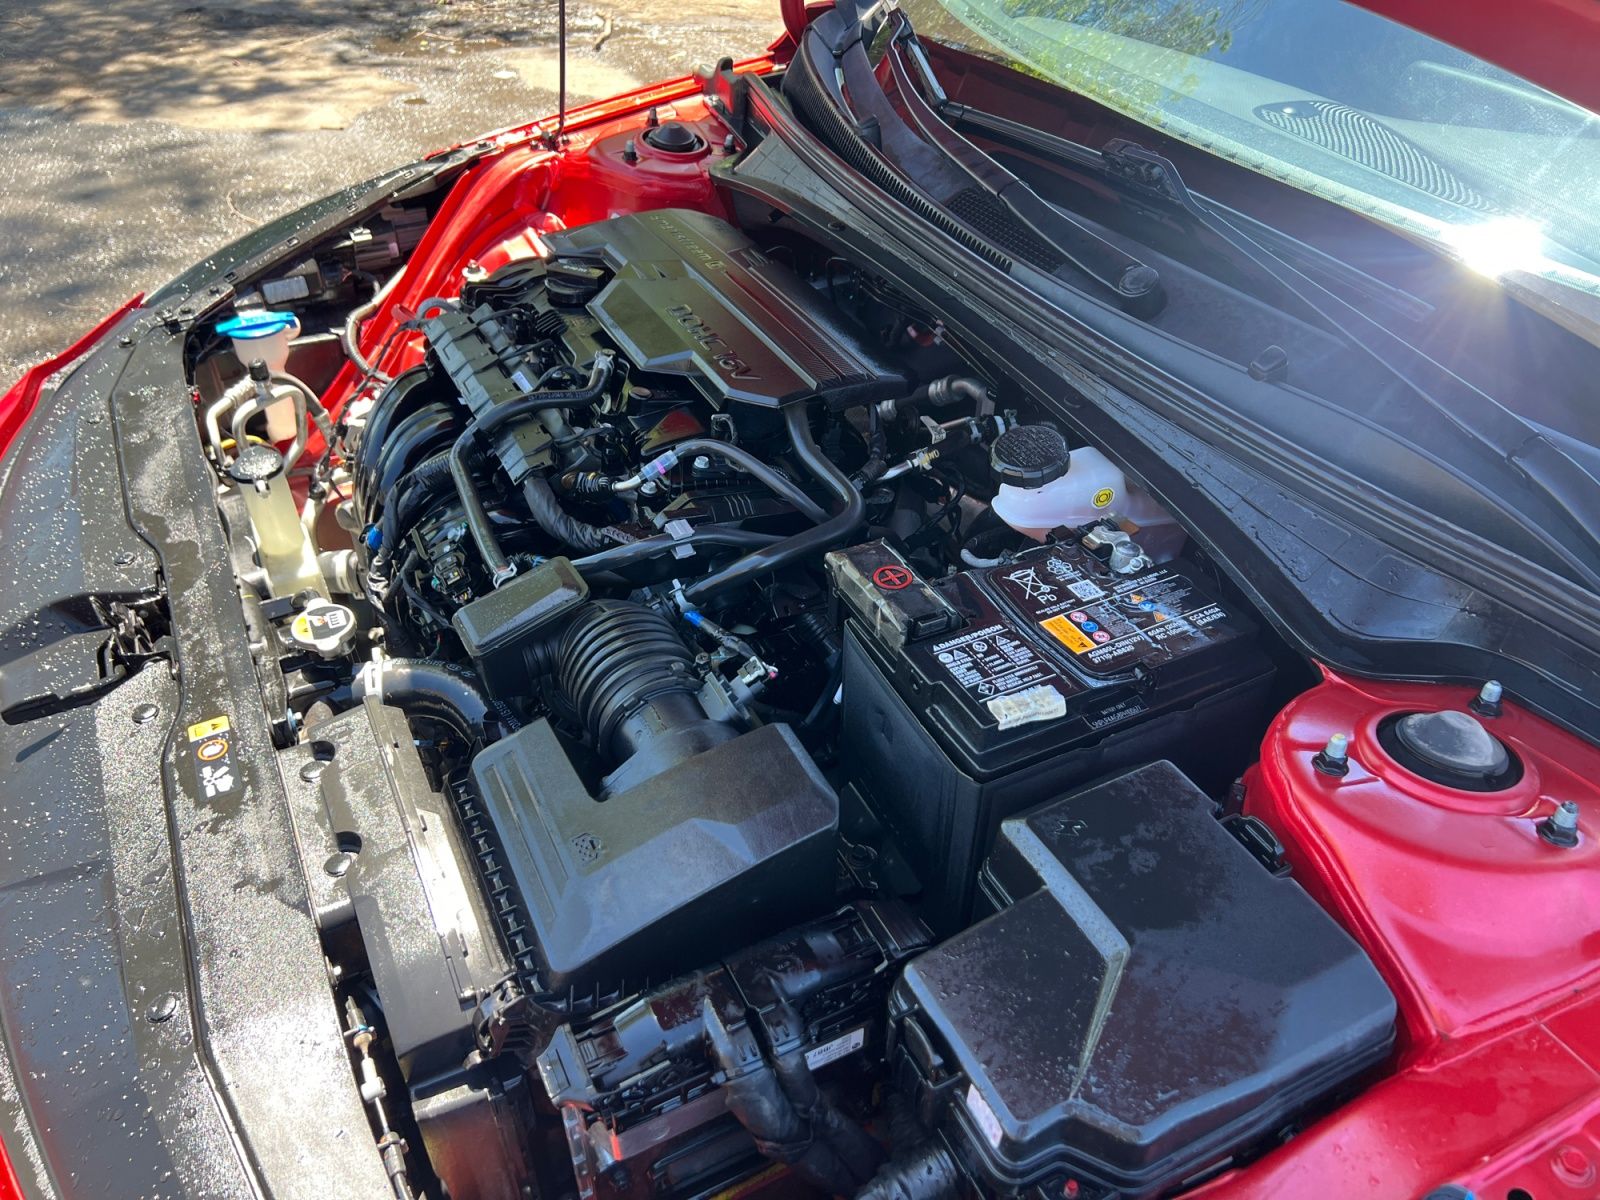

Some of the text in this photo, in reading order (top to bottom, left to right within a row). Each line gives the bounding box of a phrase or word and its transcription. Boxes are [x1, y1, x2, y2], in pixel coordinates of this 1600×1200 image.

[665, 303, 763, 380] DOHC 16V
[1037, 594, 1057, 605] Pb
[1189, 611, 1204, 622] CCA
[939, 624, 1003, 649] DANGER/POISON
[1155, 633, 1168, 641] RC
